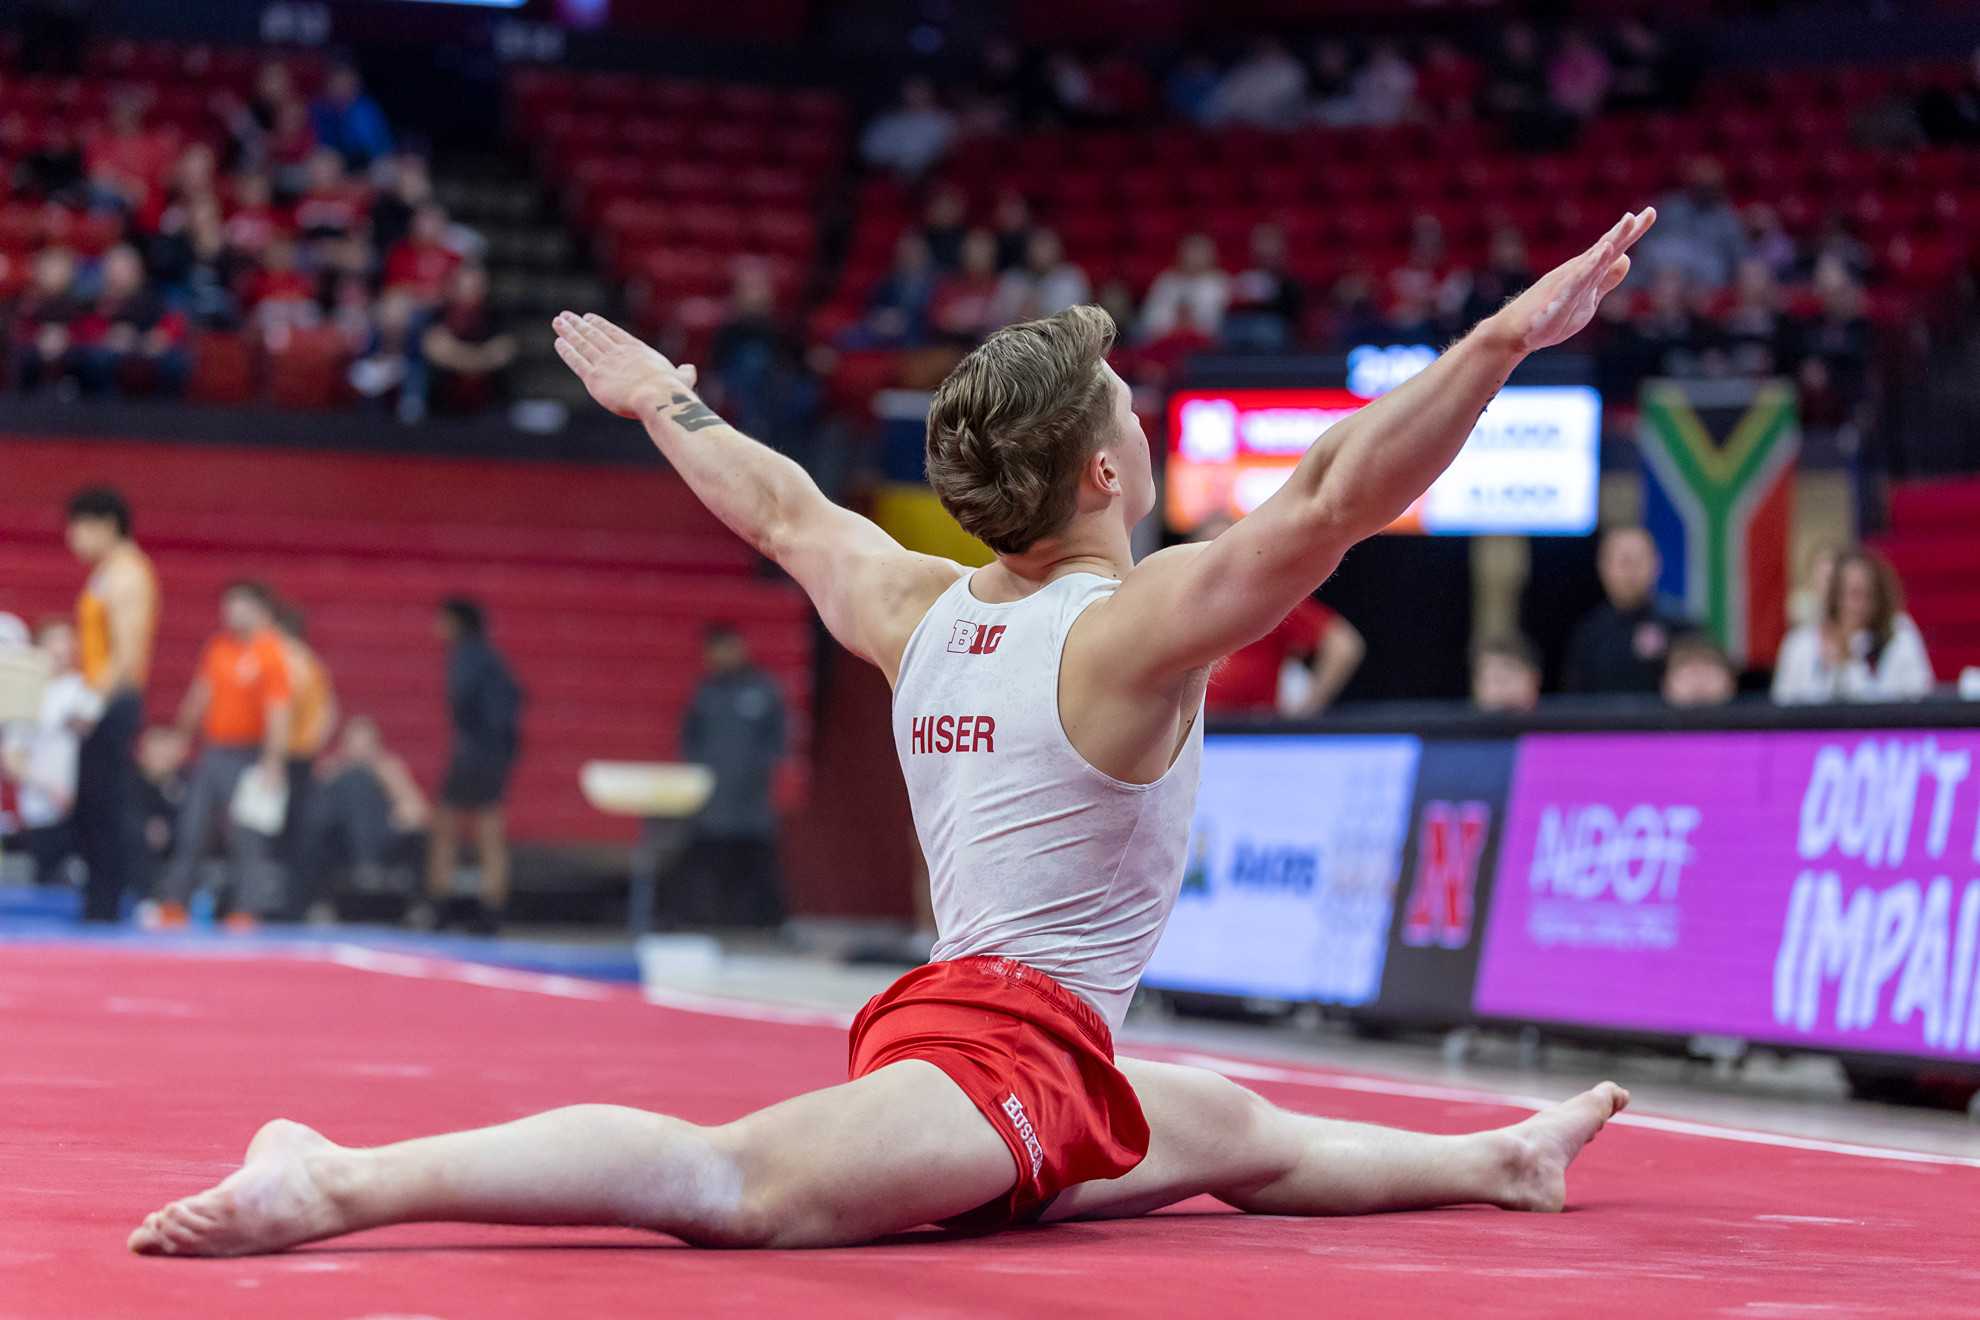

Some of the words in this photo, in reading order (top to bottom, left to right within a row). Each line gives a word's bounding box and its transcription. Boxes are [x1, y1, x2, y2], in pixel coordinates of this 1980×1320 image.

[912, 715, 995, 754] HISER
[1798, 736, 1971, 867] DON'T
[1402, 802, 1491, 948] N
